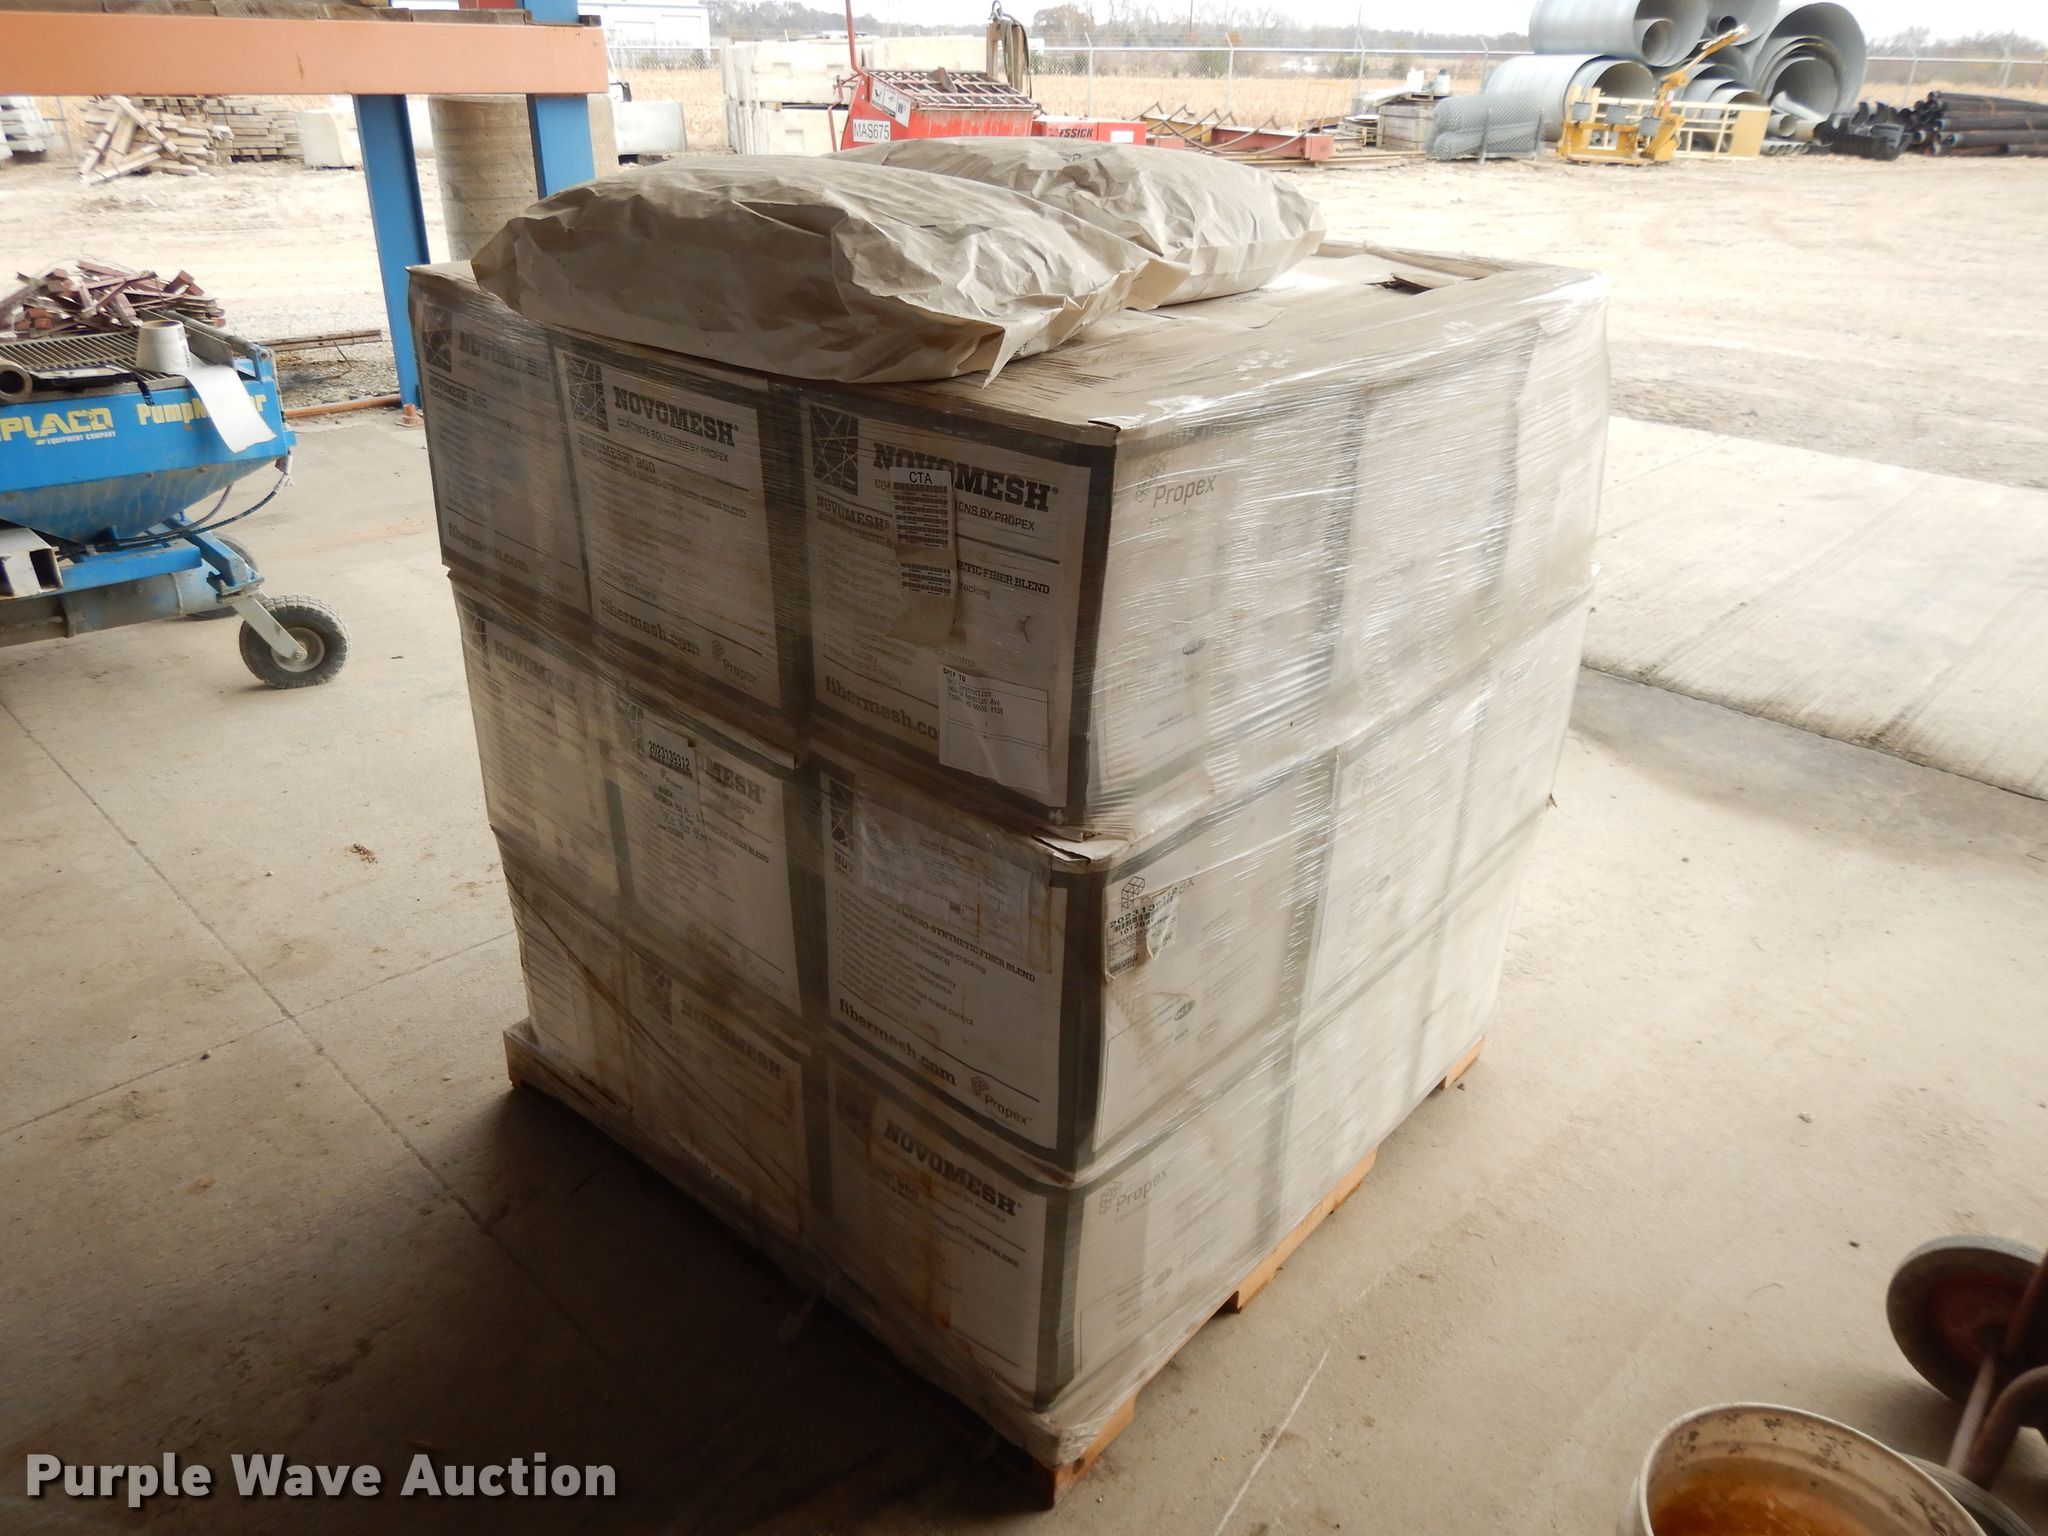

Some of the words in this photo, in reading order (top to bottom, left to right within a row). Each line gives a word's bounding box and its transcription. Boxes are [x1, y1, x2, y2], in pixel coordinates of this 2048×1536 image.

[854, 122, 890, 140] MAS675
[0, 407, 114, 441] PLACO
[47, 433, 84, 445] EQUIPMENT
[86, 430, 117, 441] COMPANY
[908, 471, 934, 485] CTA
[1152, 475, 1216, 508] Propex
[979, 505, 992, 518] BY
[994, 510, 1036, 532] PROPEX
[1014, 575, 1050, 595] BLEND
[824, 675, 940, 741] fibermesh.co
[1005, 960, 1037, 984] BLEND
[839, 997, 957, 1087] fibermesh.com
